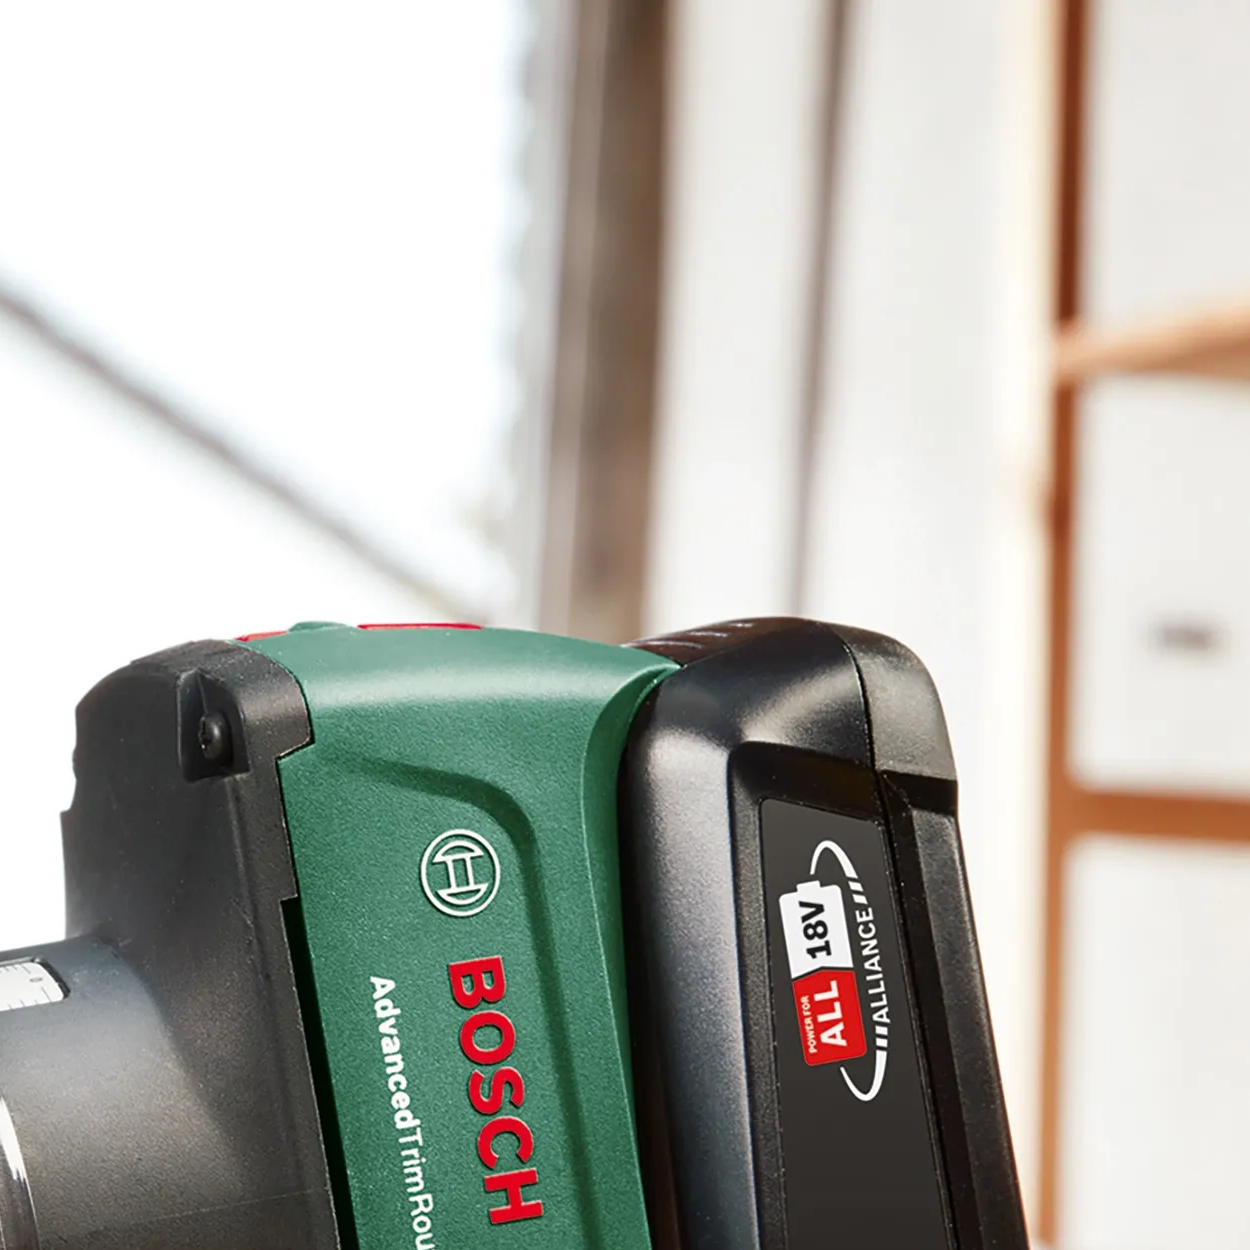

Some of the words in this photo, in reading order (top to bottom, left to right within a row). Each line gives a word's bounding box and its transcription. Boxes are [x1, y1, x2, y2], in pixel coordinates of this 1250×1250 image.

[798, 900, 832, 959] 18V
[855, 907, 891, 1024] ALLIANCE
[801, 995, 812, 1016] FOR
[804, 1017, 817, 1054] POWER
[814, 980, 848, 1047] ALL
[449, 955, 544, 1225] BOSCH
